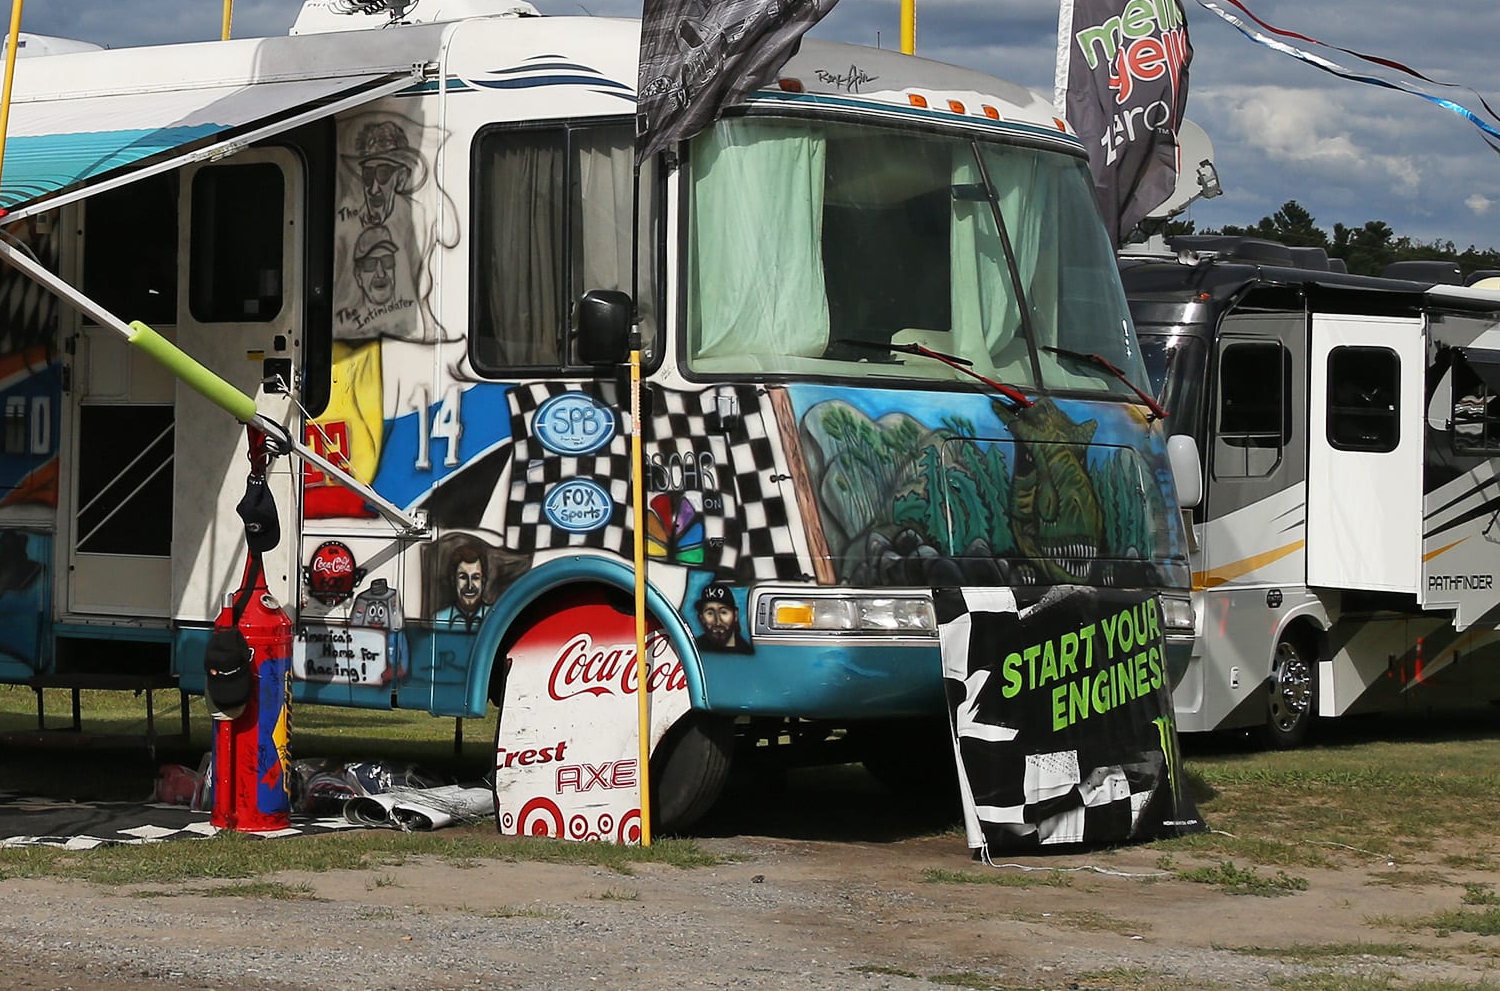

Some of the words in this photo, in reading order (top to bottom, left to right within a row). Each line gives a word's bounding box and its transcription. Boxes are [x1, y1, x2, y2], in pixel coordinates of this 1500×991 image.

[1100, 100, 1170, 167] zero
[407, 385, 464, 472] 14
[562, 488, 596, 506] FOX
[703, 498, 722, 510] ON
[560, 509, 601, 523] Sports
[1428, 574, 1493, 591] PATHFINDER
[298, 626, 353, 643] America's
[322, 642, 356, 659] Home
[1001, 623, 1096, 699] START
[1100, 597, 1162, 659] YOUR
[1051, 643, 1166, 732] ENGINES!
[555, 758, 638, 795] AXE
